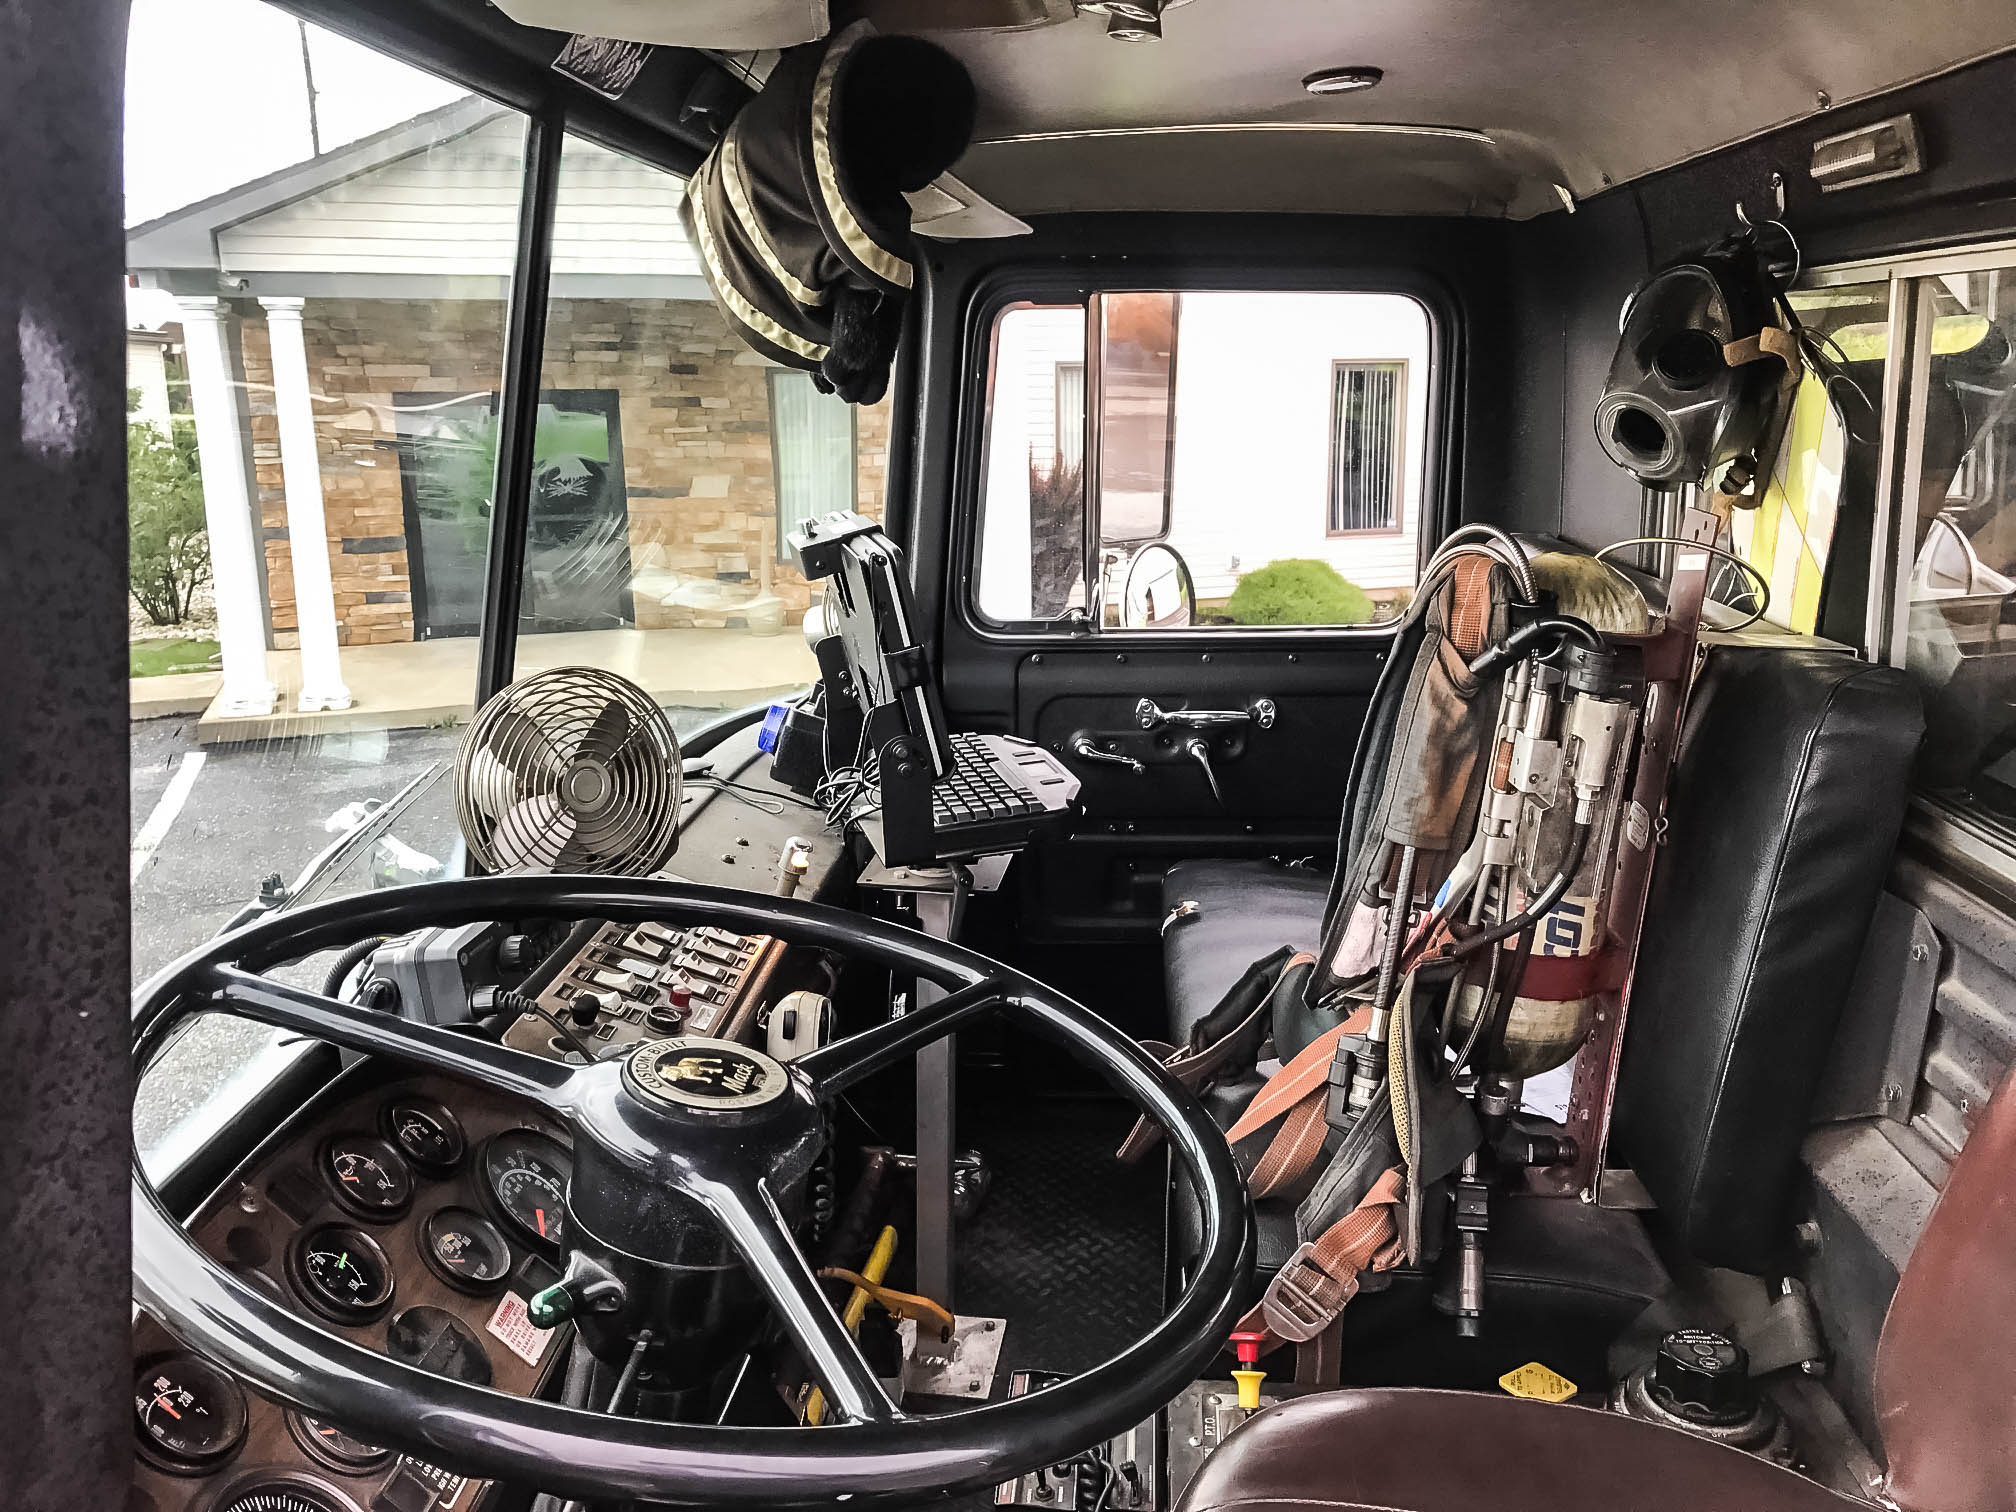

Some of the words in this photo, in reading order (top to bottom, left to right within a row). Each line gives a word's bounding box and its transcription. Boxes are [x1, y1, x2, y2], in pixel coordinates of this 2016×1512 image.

[721, 1062, 755, 1095] Mack
[494, 1299, 515, 1327] WARNING
[153, 1376, 171, 1392] 200
[177, 1391, 194, 1407] 230
